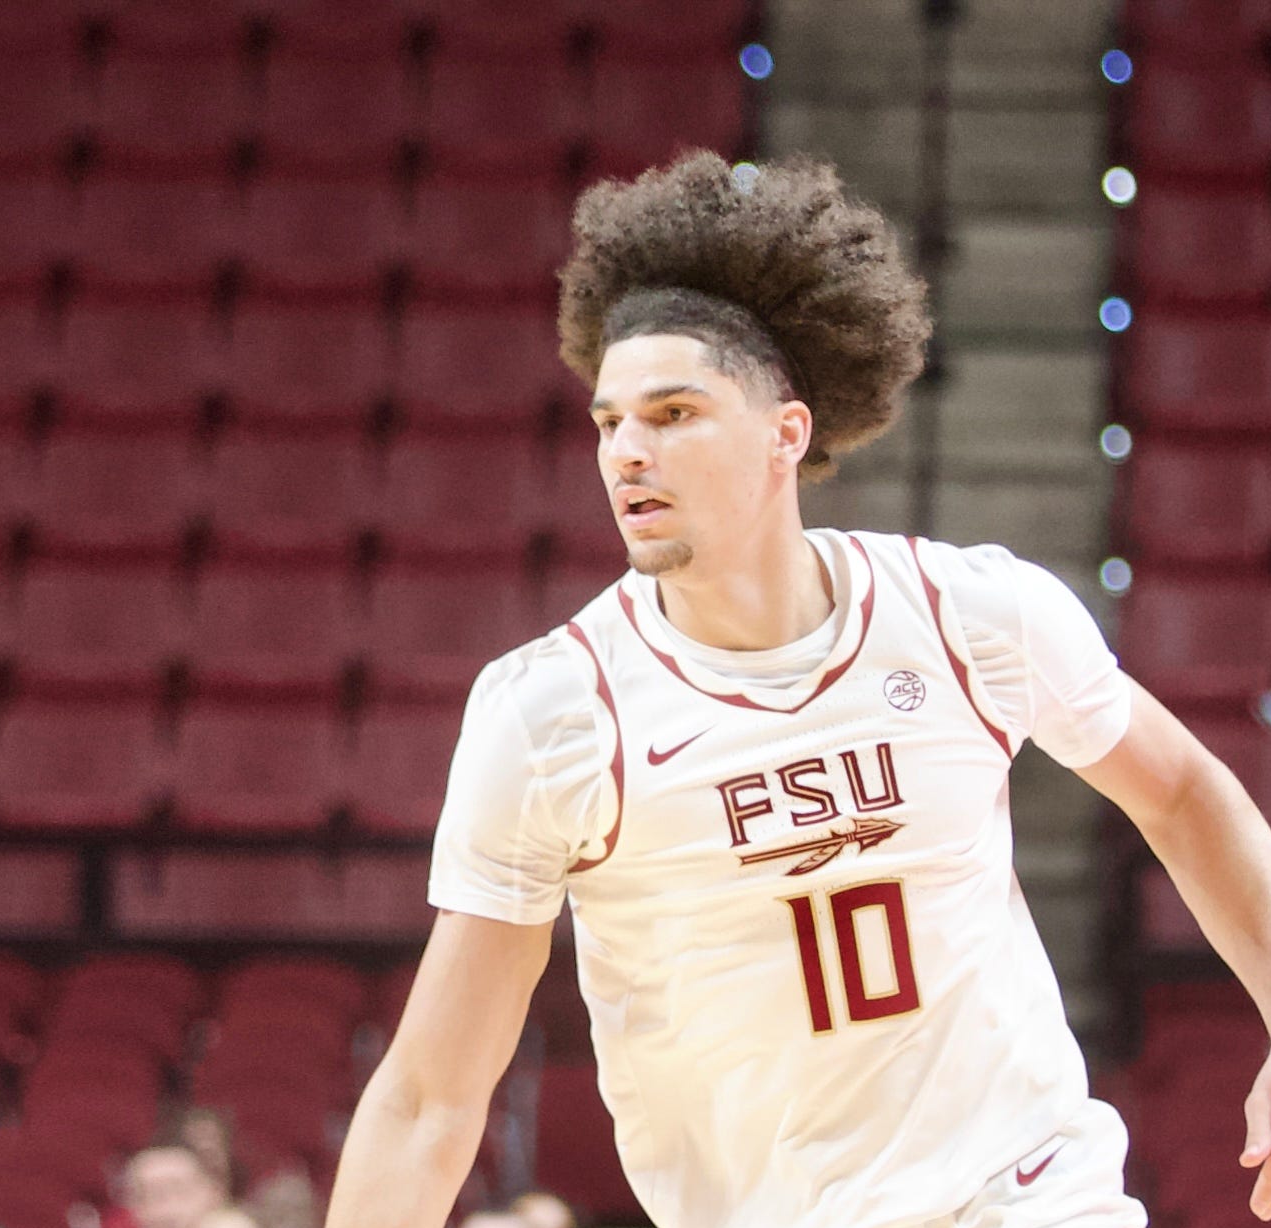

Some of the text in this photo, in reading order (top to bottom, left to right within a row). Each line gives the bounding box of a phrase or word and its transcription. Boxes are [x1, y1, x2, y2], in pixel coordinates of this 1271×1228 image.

[889, 680, 921, 699] ACC
[714, 743, 904, 848] FSU
[775, 877, 922, 1037] 10
